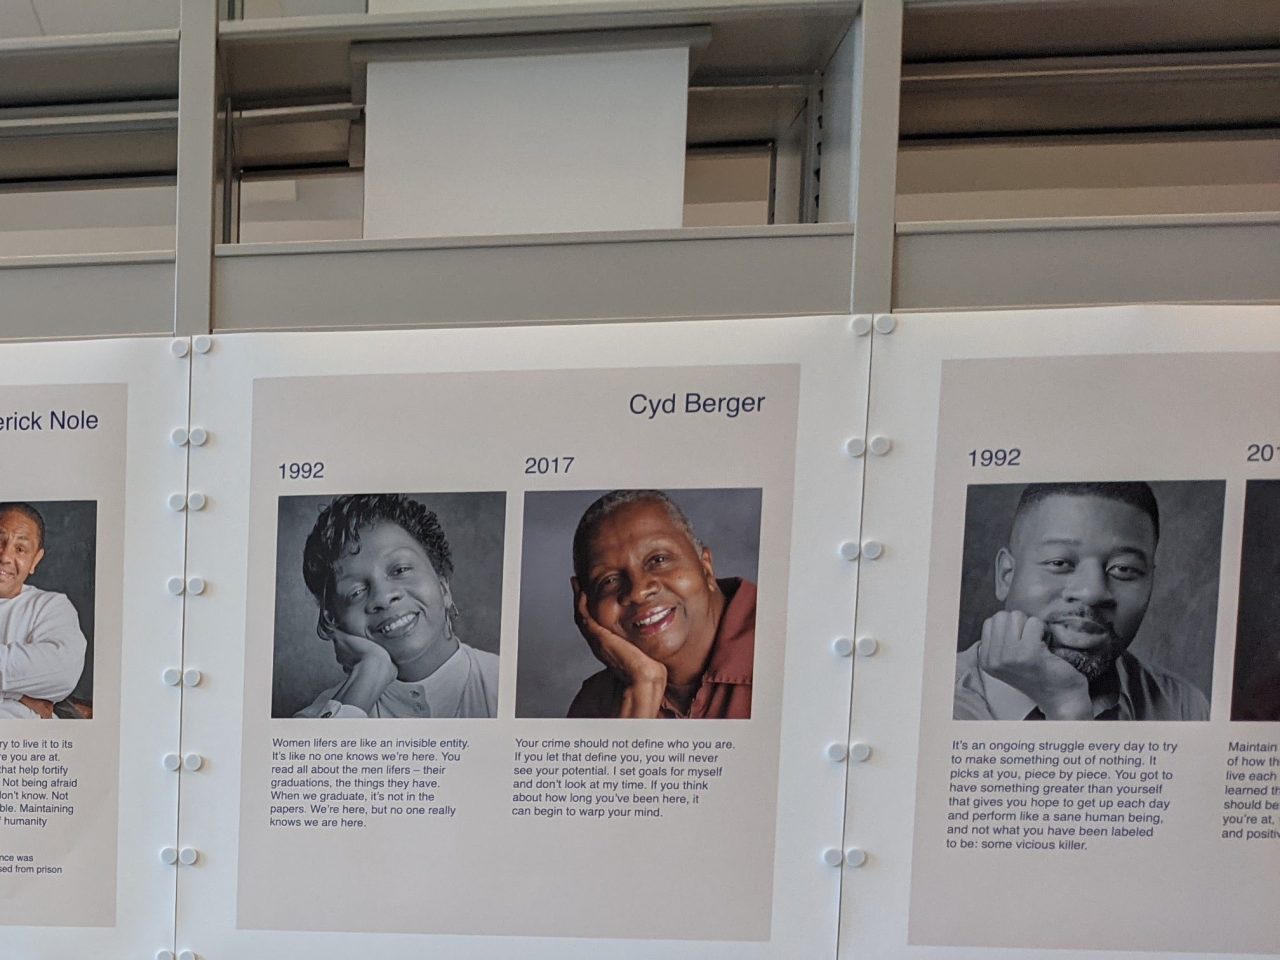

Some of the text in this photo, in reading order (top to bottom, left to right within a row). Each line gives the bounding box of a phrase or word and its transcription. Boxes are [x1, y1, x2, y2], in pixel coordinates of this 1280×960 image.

[629, 392, 766, 420] Cyd Berger
[50, 409, 99, 430] Nole
[968, 448, 1021, 467] 1992
[278, 461, 325, 480] 1992
[524, 456, 575, 475] 2017
[272, 737, 469, 749] Women lifers are like an invisible entity.
[515, 737, 539, 747] Your
[541, 738, 570, 747] crime
[573, 738, 608, 748] should
[611, 739, 628, 748] not
[631, 738, 664, 748] define
[666, 738, 689, 748] who
[692, 741, 711, 750] you
[952, 739, 1178, 753] It's an ongoing struggle every day to try
[1228, 742, 1277, 752] Maintain
[272, 750, 286, 760] It's
[288, 750, 306, 760] like
[345, 751, 378, 760] knows
[380, 751, 409, 760] we're
[411, 751, 437, 761] here.
[441, 751, 460, 761] You
[1227, 757, 1265, 766] of how
[18, 764, 39, 775] help
[41, 764, 68, 775] fortify
[1226, 771, 1277, 780] live each
[270, 777, 440, 789] graduations, the things they have.
[1225, 785, 1268, 795] learned
[1224, 800, 1280, 809] should be
[511, 805, 662, 818] can begin to warp your mind.
[269, 816, 301, 826] knows
[303, 818, 318, 826] we
[340, 817, 366, 827] here.
[1223, 814, 1257, 825] you're
[946, 837, 1087, 849] to be: some vicious killer.
[14, 863, 34, 873] from
[36, 864, 62, 875] prison
